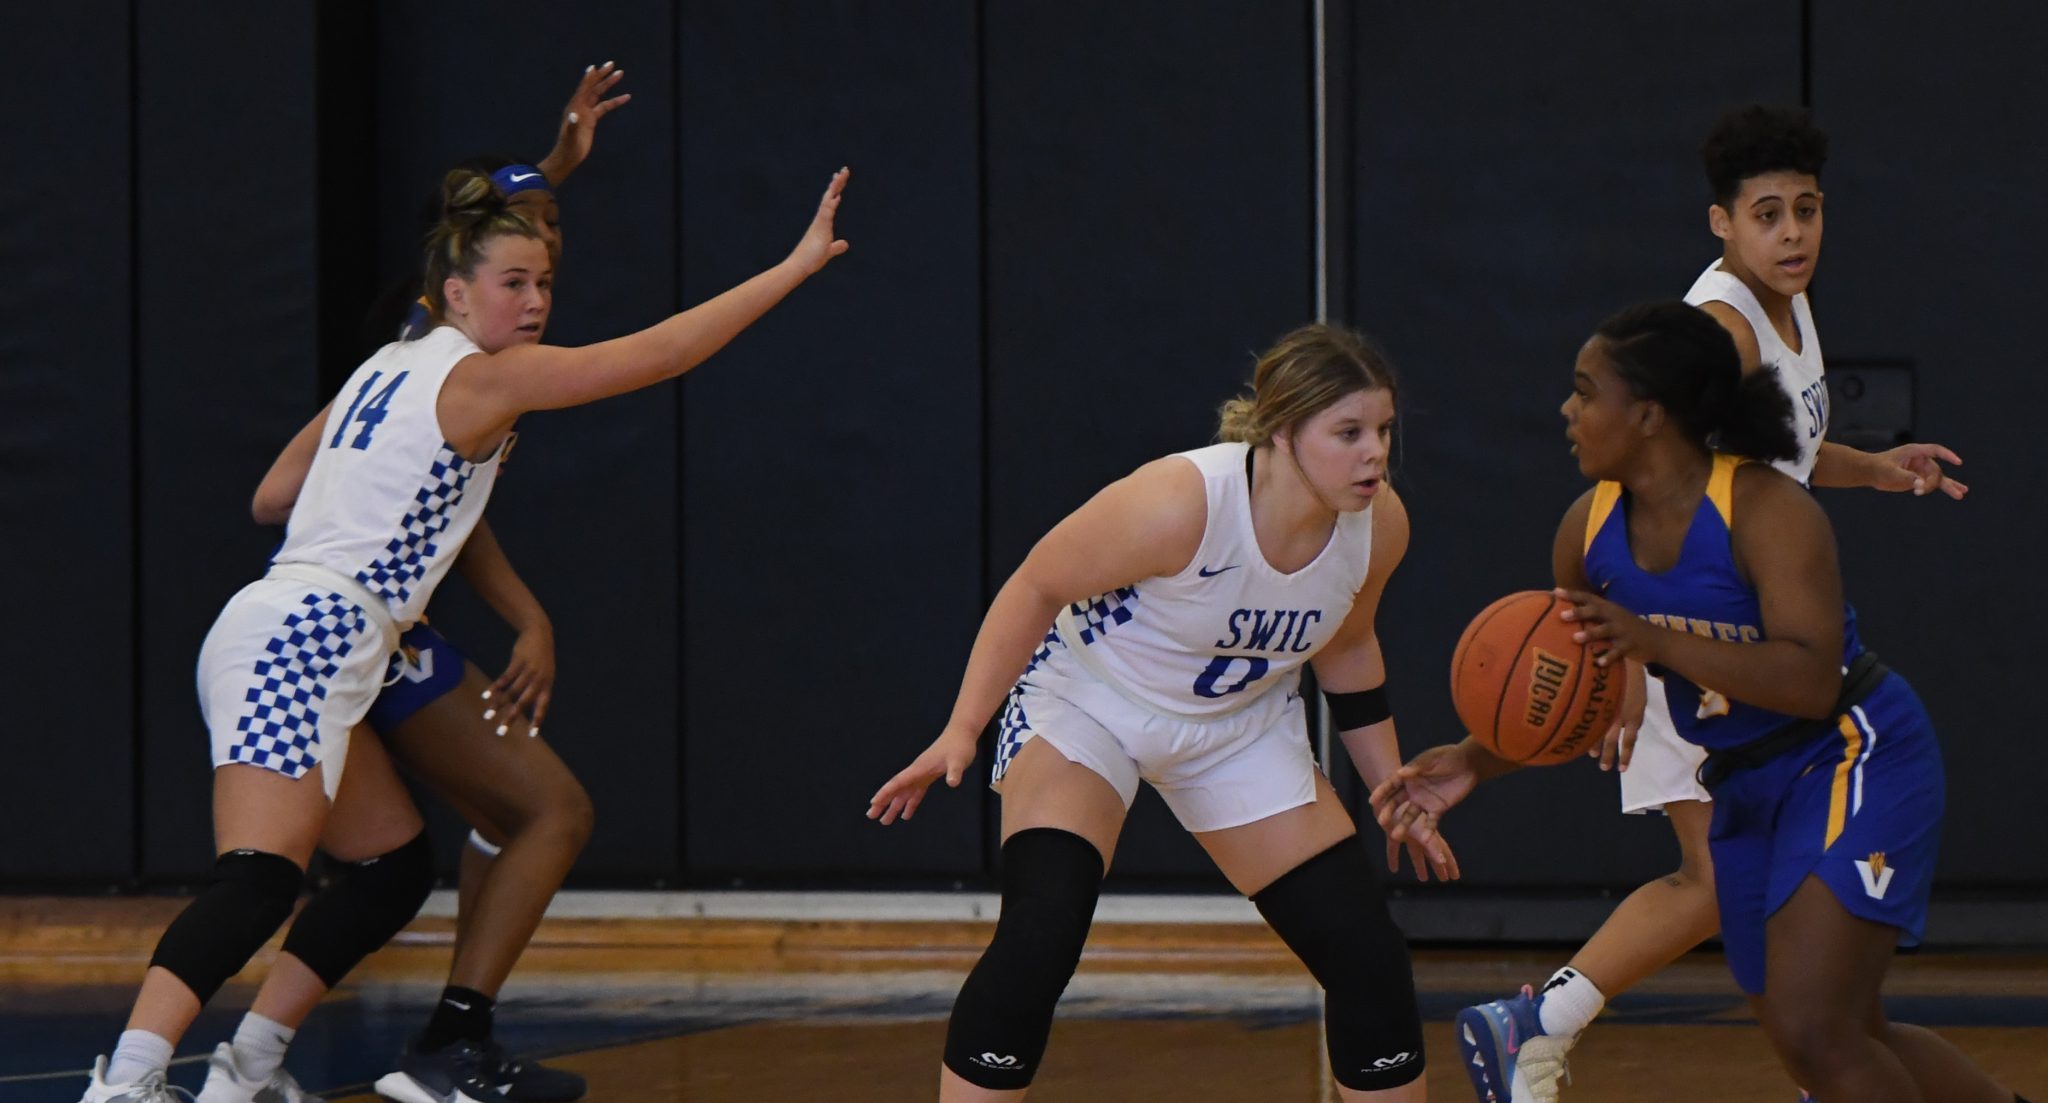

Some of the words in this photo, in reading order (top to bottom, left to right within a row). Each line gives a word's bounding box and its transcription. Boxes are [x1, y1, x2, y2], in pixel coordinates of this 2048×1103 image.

[328, 369, 411, 451] 14
[1214, 608, 1322, 653] SWIC
[1192, 655, 1270, 699] 0
[1525, 652, 1569, 728] NJCAA
